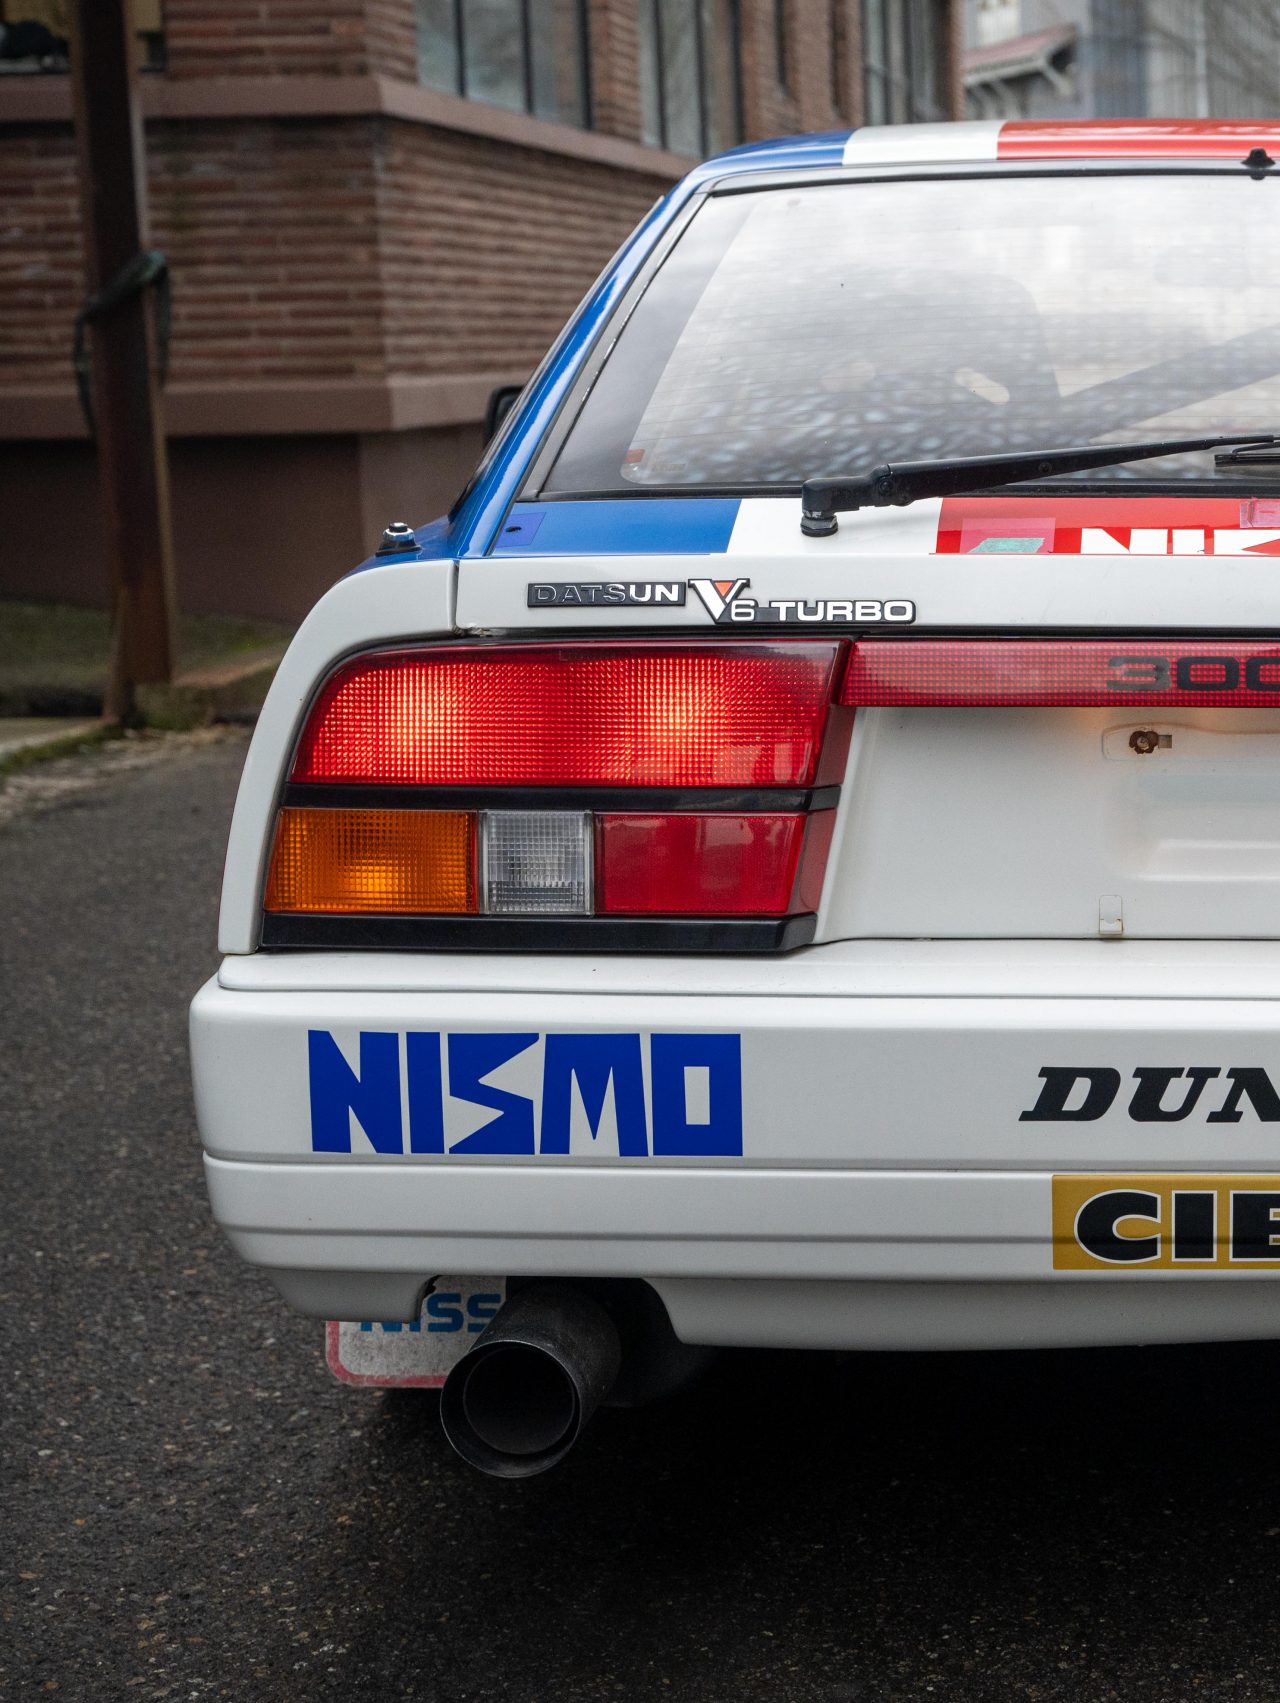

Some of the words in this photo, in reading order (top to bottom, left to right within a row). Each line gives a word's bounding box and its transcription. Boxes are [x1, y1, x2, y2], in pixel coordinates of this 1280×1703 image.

[535, 582, 680, 604] DATSUN
[772, 600, 915, 622] TURBO
[308, 1030, 743, 1157] NISMO
